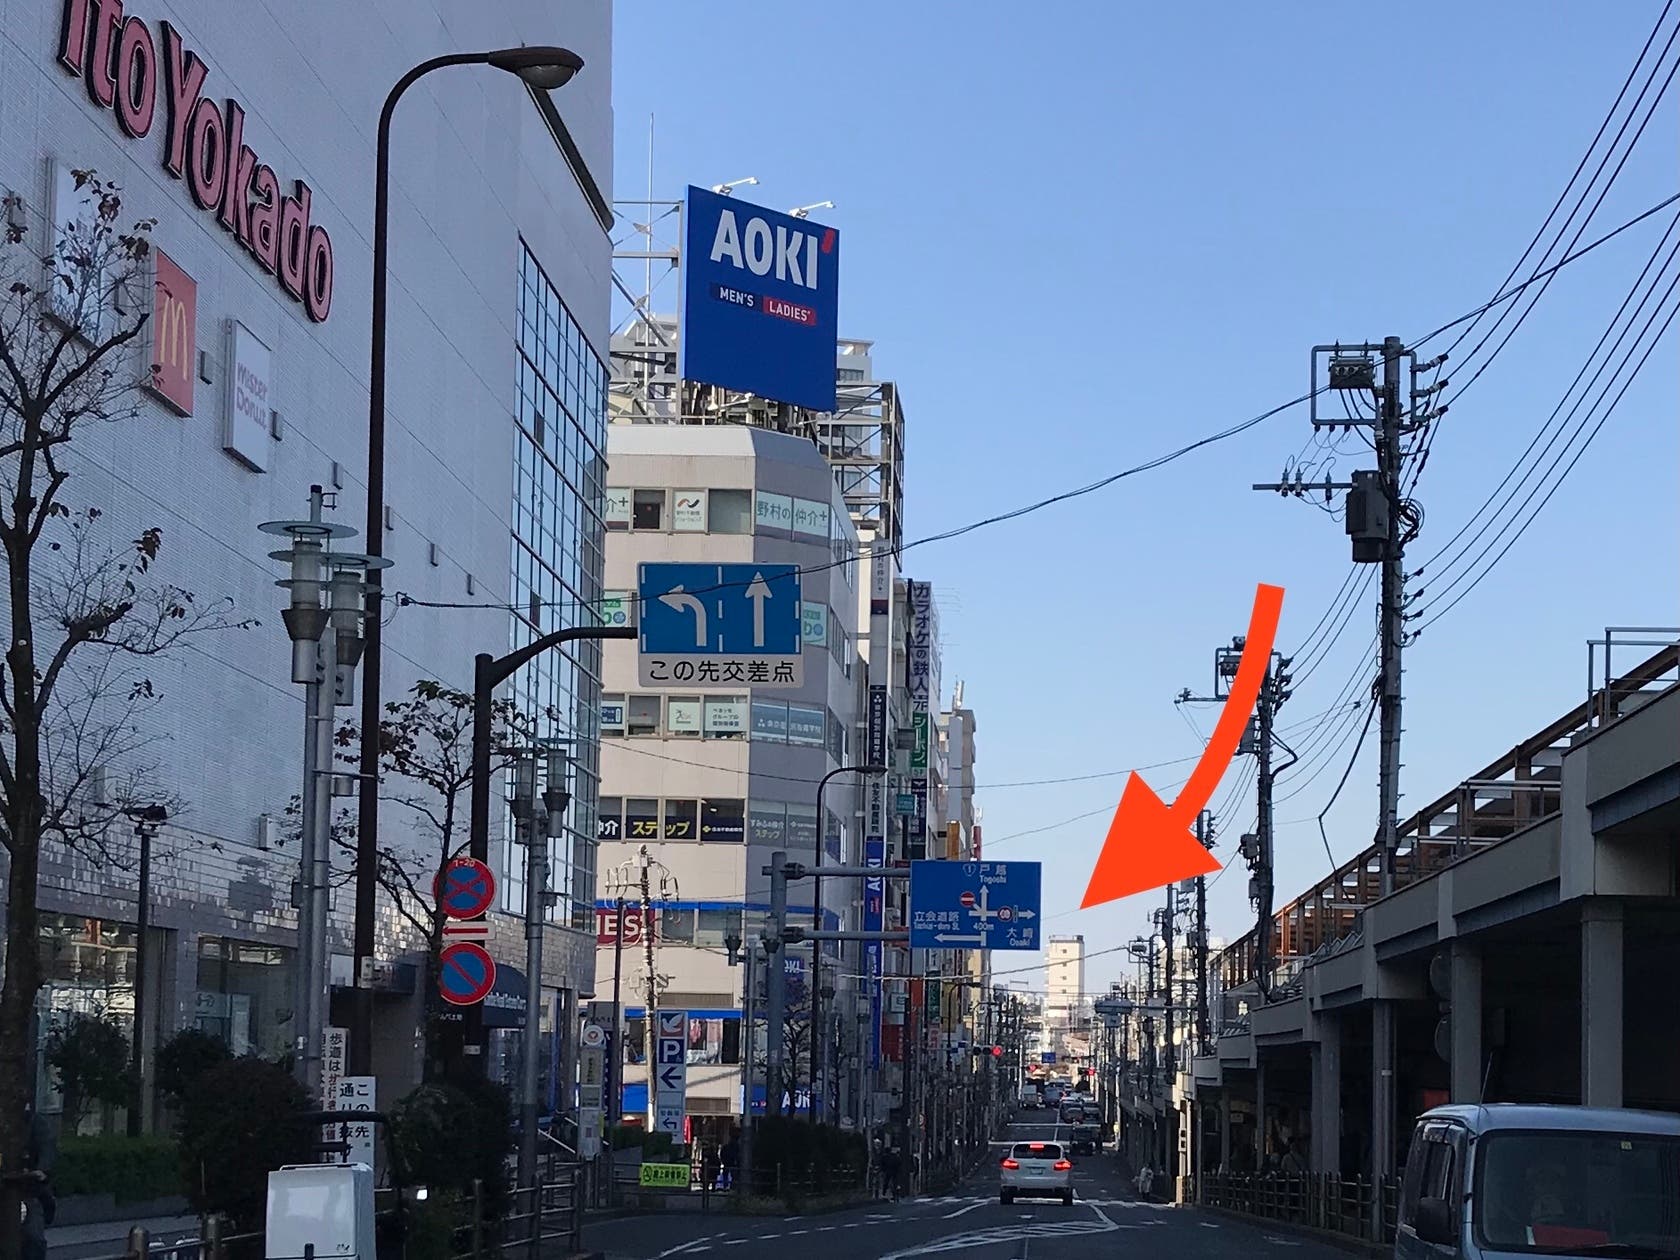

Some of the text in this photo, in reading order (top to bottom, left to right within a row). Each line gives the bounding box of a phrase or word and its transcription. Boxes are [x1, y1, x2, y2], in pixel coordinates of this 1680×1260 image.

[710, 209, 818, 290] AOKI
[650, 660, 795, 683] この先交差点
[632, 820, 690, 836] ステップ
[973, 922, 994, 931] 400m
[663, 1041, 680, 1062] P
